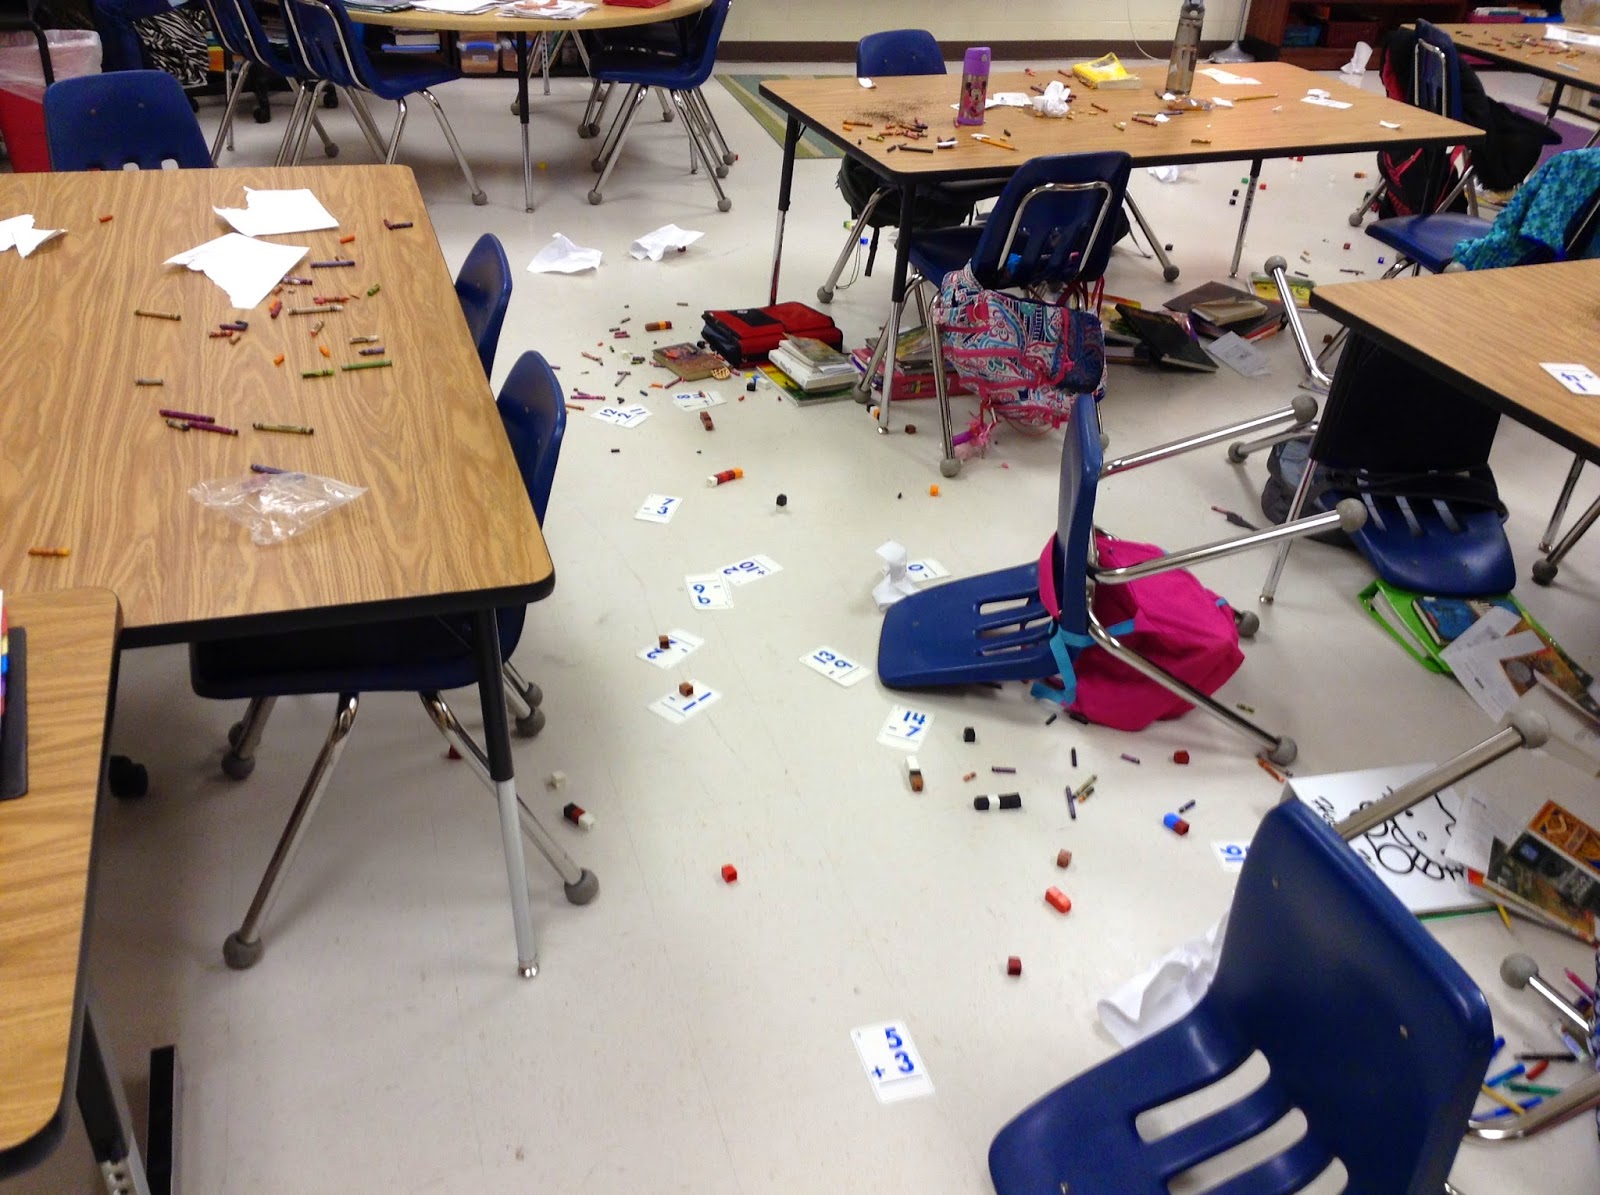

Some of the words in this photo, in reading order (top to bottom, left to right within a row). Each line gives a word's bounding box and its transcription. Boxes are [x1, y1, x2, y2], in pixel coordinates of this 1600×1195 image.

[662, 497, 676, 506] 7
[656, 506, 669, 515] 3
[813, 650, 836, 665] 13
[902, 710, 927, 726] 14
[905, 725, 922, 737] 7
[884, 1026, 903, 1049] 5
[894, 1050, 915, 1073] 3
